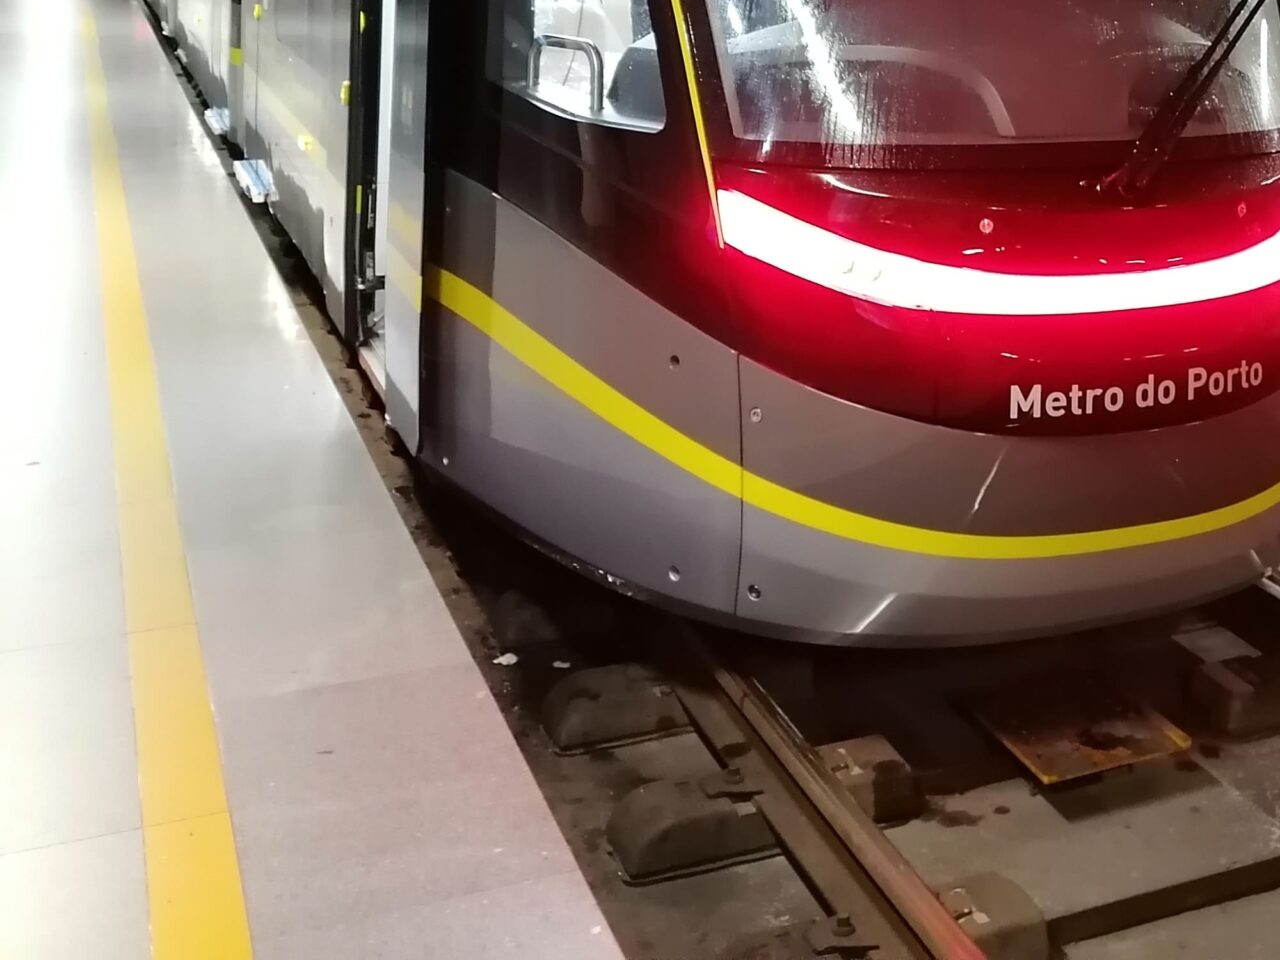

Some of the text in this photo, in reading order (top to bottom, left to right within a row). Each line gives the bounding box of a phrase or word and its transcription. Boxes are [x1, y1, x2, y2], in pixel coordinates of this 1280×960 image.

[1009, 359, 1264, 419] Metro do Porto
